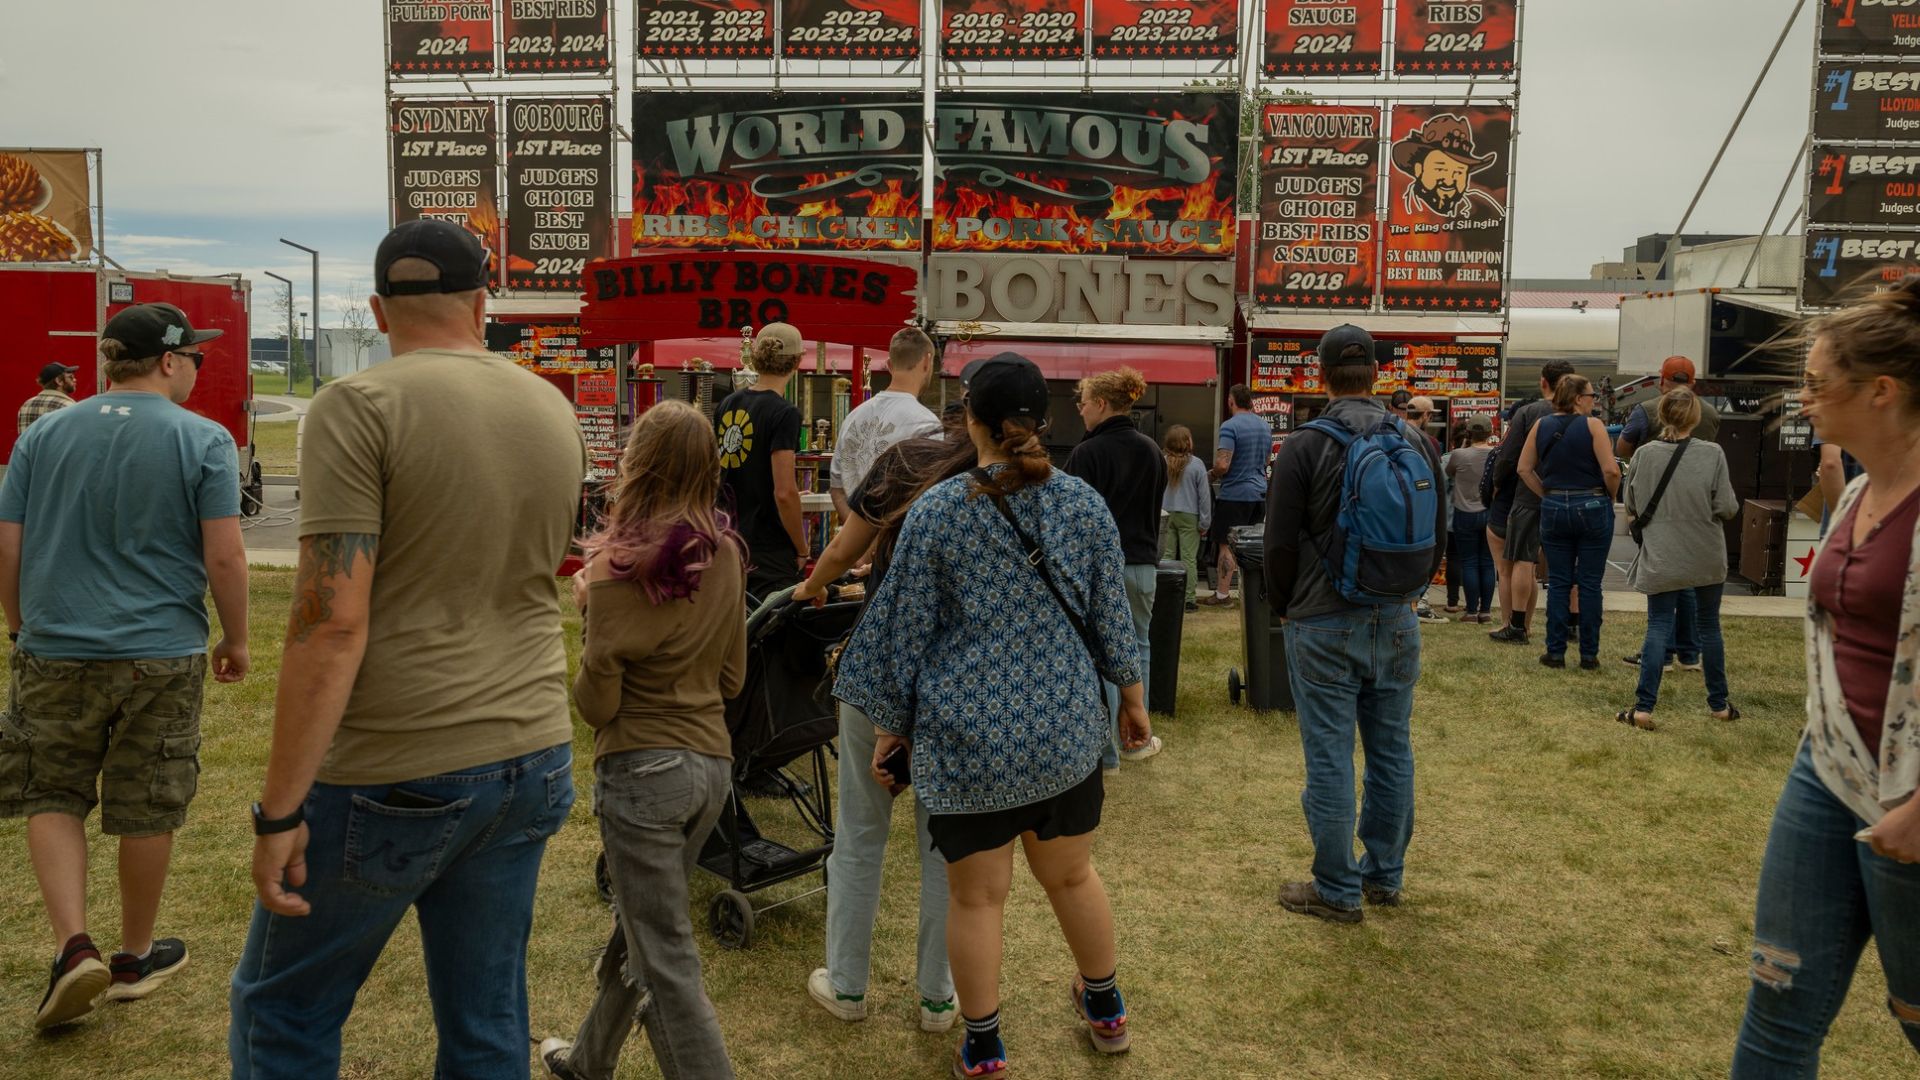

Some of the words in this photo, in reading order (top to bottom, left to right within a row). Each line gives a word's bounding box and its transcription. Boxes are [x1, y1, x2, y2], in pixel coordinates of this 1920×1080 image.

[392, 4, 447, 22] PULLED
[451, 3, 490, 20] PORK
[512, 1, 554, 19] BEST
[558, 0, 596, 18] RIBS
[821, 10, 882, 26] 2022
[1139, 9, 1192, 25] 2022
[1288, 7, 1356, 25] SAUCE
[1428, 5, 1483, 24] RIBS
[646, 10, 705, 29] 2021,
[710, 10, 765, 26] 2022
[950, 13, 1004, 28] 2016
[1020, 12, 1075, 27] 2020
[645, 27, 704, 45] 2023,
[709, 26, 764, 42] 2024
[788, 26, 914, 45] 2023,2024
[949, 29, 1004, 43] 2022
[1020, 28, 1075, 43] 2024
[1110, 26, 1218, 45] 2023,2024
[1293, 34, 1354, 54] 2024
[1424, 32, 1485, 52] 2024
[416, 38, 469, 55] 2024
[507, 36, 556, 56] 2023,
[560, 34, 605, 53] 2024
[1824, 70, 1852, 111] #1
[399, 107, 488, 133] SYDNEY
[514, 104, 603, 132] COBOURG
[1268, 113, 1374, 138] VANCOUVER
[1885, 118, 1920, 131] Judges
[401, 141, 434, 157] 1ST
[435, 140, 487, 157] Place
[515, 140, 547, 156] 1ST
[548, 140, 602, 156] Place
[666, 109, 906, 178] WORLD
[935, 108, 1211, 184] FAMOUS
[1271, 147, 1307, 165] 1ST
[1309, 149, 1369, 166] Place
[405, 170, 480, 187] JUDGE'S
[520, 168, 598, 186] JUDGE'S
[1818, 153, 1847, 195] #1
[1848, 155, 1920, 175] BEST
[1275, 177, 1362, 195] JUDGE'S
[1886, 182, 1914, 197] COLD
[409, 191, 476, 208] CHOICE
[525, 190, 594, 207] CHOICE
[1279, 200, 1356, 218] CHOICE
[1880, 202, 1914, 216] Judges
[535, 212, 585, 229] BEST
[643, 214, 731, 238] RIBS
[752, 215, 922, 240] CHICKEN
[956, 217, 1071, 242] PORK
[1092, 219, 1222, 244] SAUCE
[1389, 224, 1410, 235] The
[1414, 222, 1440, 234] King
[1442, 220, 1455, 232] of
[1263, 223, 1317, 241] BEST
[1321, 224, 1370, 242] RIBS
[529, 233, 590, 250] SAUCE
[1273, 246, 1290, 264] &
[1292, 247, 1358, 264] SAUCE
[1386, 250, 1401, 263] 5X
[1404, 250, 1441, 264] GRAND
[1445, 250, 1502, 265] CHAMPION
[1812, 237, 1840, 278] #1
[1840, 239, 1915, 260] BEST
[534, 258, 586, 275] 2024
[1387, 268, 1413, 281] BEST
[1417, 268, 1443, 281] RIBS
[594, 261, 721, 301] BILLY
[734, 262, 891, 304] BONES
[1286, 272, 1344, 290] 2018
[935, 258, 1235, 326] BONES
[697, 298, 789, 330] BBQ
[1268, 342, 1283, 351] BBQ
[1284, 342, 1300, 351] RIBS
[1448, 346, 1461, 355] BBQ
[1464, 347, 1496, 355] COMBOS
[1258, 355, 1274, 364] THIRD
[1275, 355, 1283, 364] OF
[1283, 355, 1287, 364] A
[1288, 355, 1302, 364] RACK
[1415, 357, 1440, 366] CHICKEN
[1258, 367, 1272, 375] HALF
[1272, 367, 1277, 375] A
[1277, 367, 1292, 376] RACK
[1414, 370, 1435, 378] PULLED
[1435, 370, 1452, 378] PORK
[1456, 370, 1468, 379] RIBS
[1258, 379, 1271, 388] FULL
[1272, 379, 1286, 388] RACK
[1414, 381, 1438, 390] CHICKEN
[1465, 382, 1480, 391] PORK
[1252, 396, 1279, 406] POTATO
[1254, 402, 1291, 413] SALAD!
